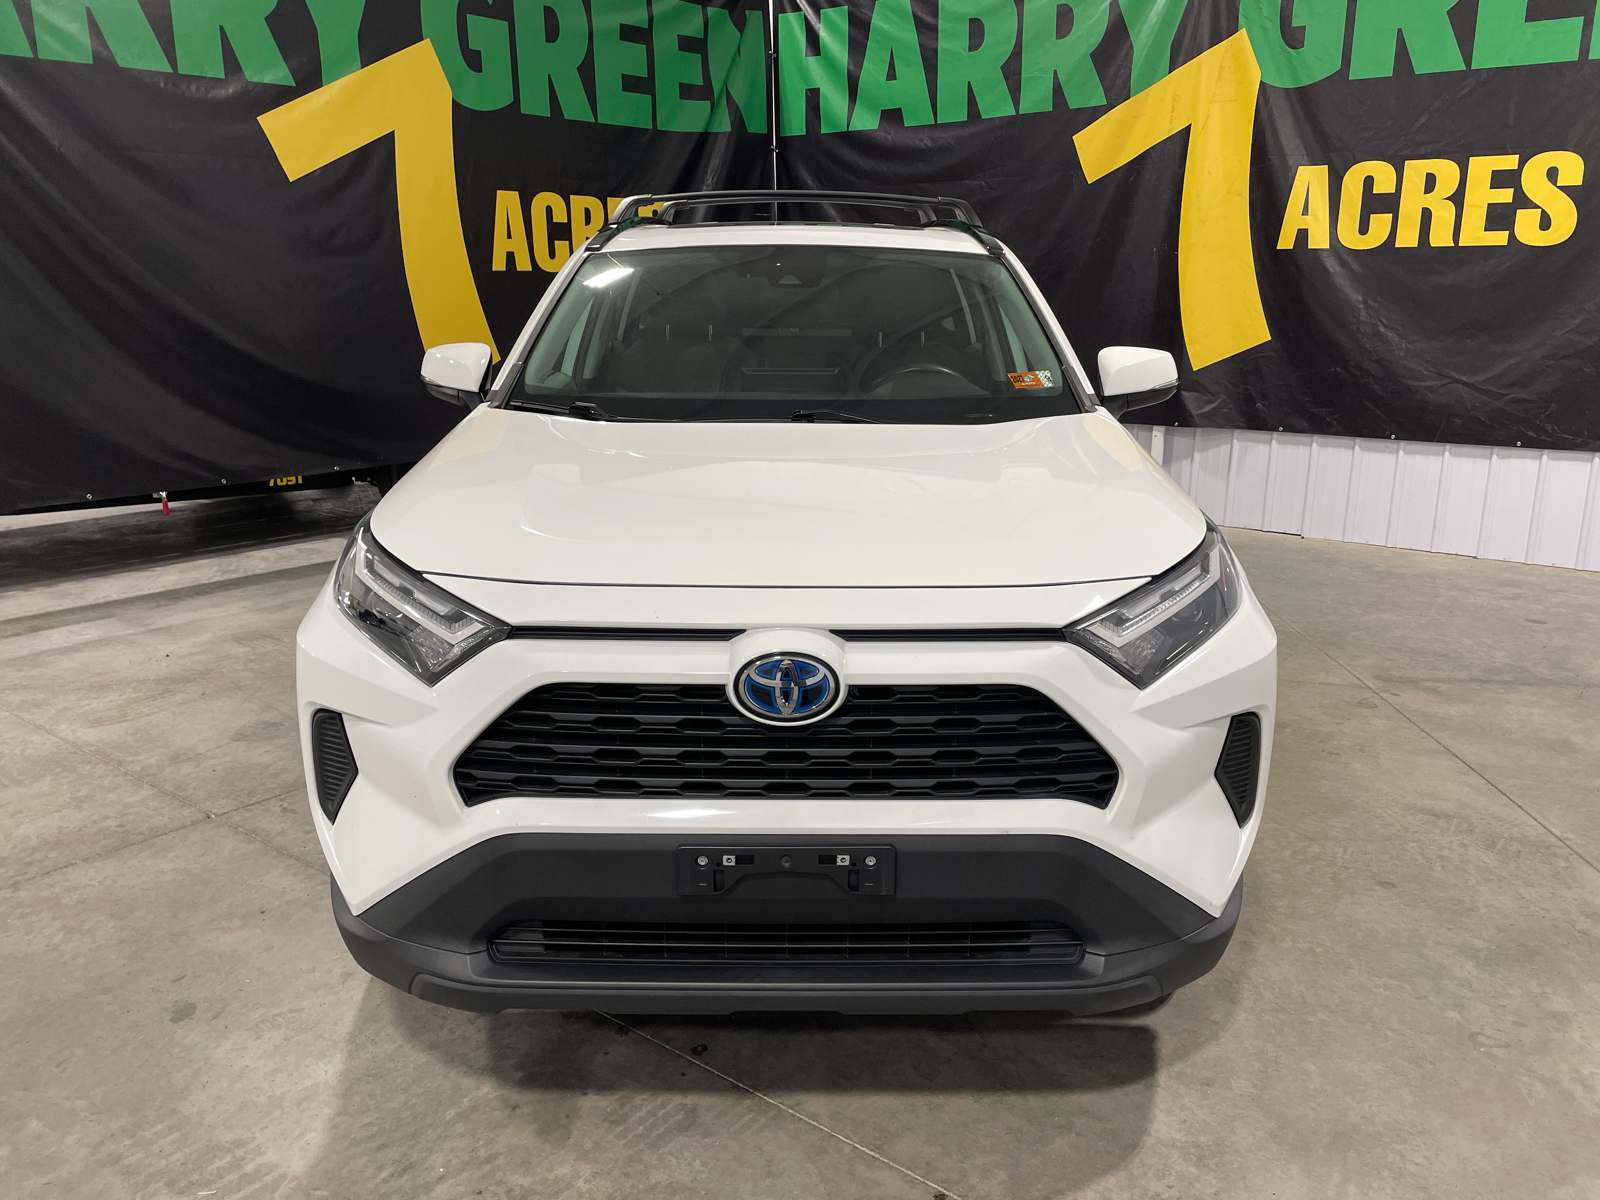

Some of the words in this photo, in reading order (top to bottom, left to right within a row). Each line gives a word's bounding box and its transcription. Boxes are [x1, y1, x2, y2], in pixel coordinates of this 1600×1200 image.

[420, 0, 768, 134] GREEN
[778, 0, 1184, 137] HARRY
[257, 38, 501, 363] 7
[491, 189, 667, 273] ACR
[1072, 27, 1271, 371] 7
[1275, 150, 1585, 250] ACRES
